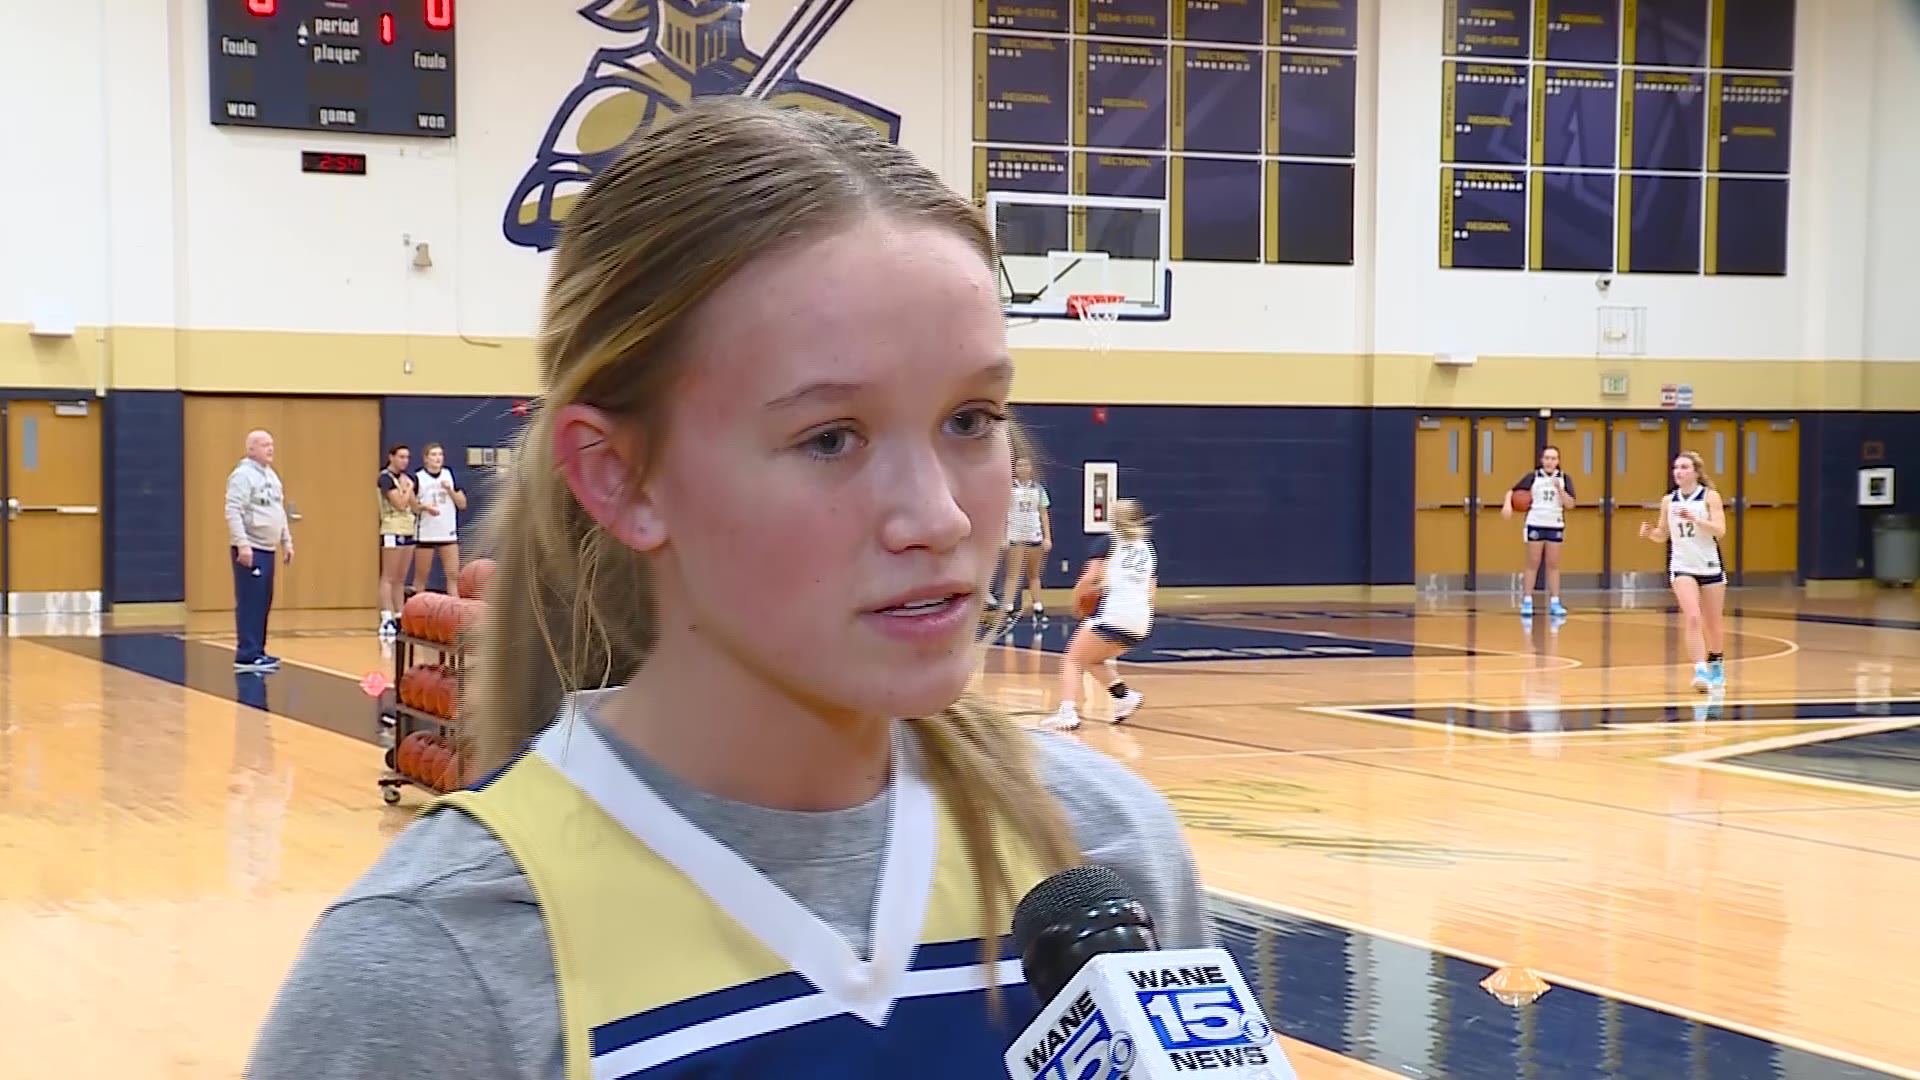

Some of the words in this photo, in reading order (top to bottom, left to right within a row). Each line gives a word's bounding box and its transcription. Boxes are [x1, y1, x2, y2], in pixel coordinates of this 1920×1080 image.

[315, 16, 359, 36] period
[381, 14, 393, 44] 1
[222, 36, 258, 56] fouls
[313, 44, 361, 64] player
[414, 51, 447, 69] fouls
[227, 102, 256, 118] won
[319, 108, 356, 126] game
[418, 115, 445, 129] won
[1677, 522, 1696, 538] 12
[1127, 966, 1228, 990] WANE
[1143, 988, 1245, 1047] 15
[1023, 990, 1097, 1074] WANE
[1169, 1046, 1269, 1073] NEWS
